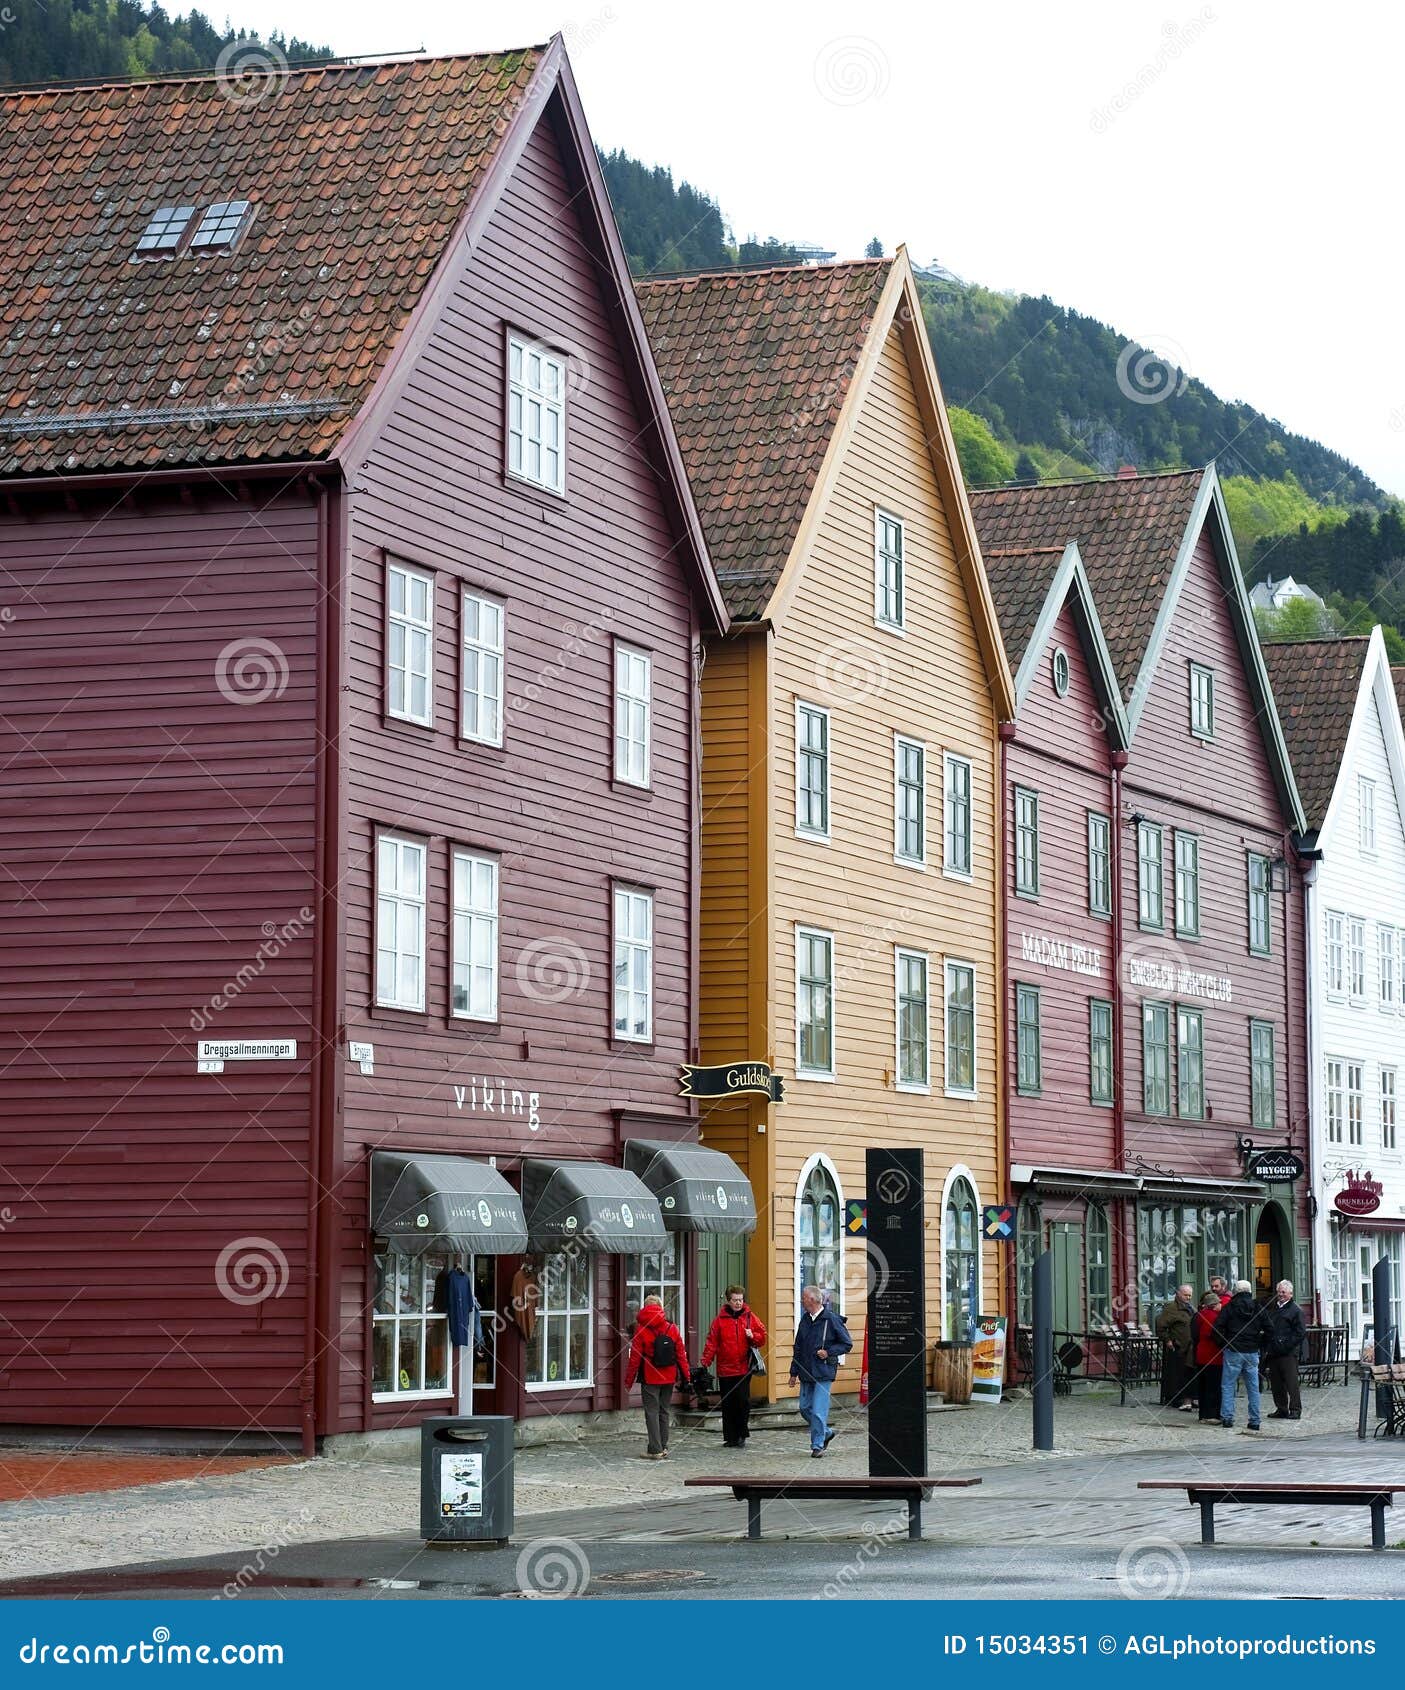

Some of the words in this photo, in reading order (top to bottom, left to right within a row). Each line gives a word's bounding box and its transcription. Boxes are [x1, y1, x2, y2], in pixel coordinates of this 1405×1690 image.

[1022, 931, 1068, 969] MADAM
[204, 1043, 290, 1057] Dreggsallmenningen
[453, 1076, 540, 1131] viking
[1256, 1166, 1297, 1174] BRYGGEN
[695, 1190, 716, 1204] viking
[728, 1191, 748, 1205] viking
[1337, 1198, 1376, 1206] BRUNELLO
[452, 1208, 477, 1222] viking
